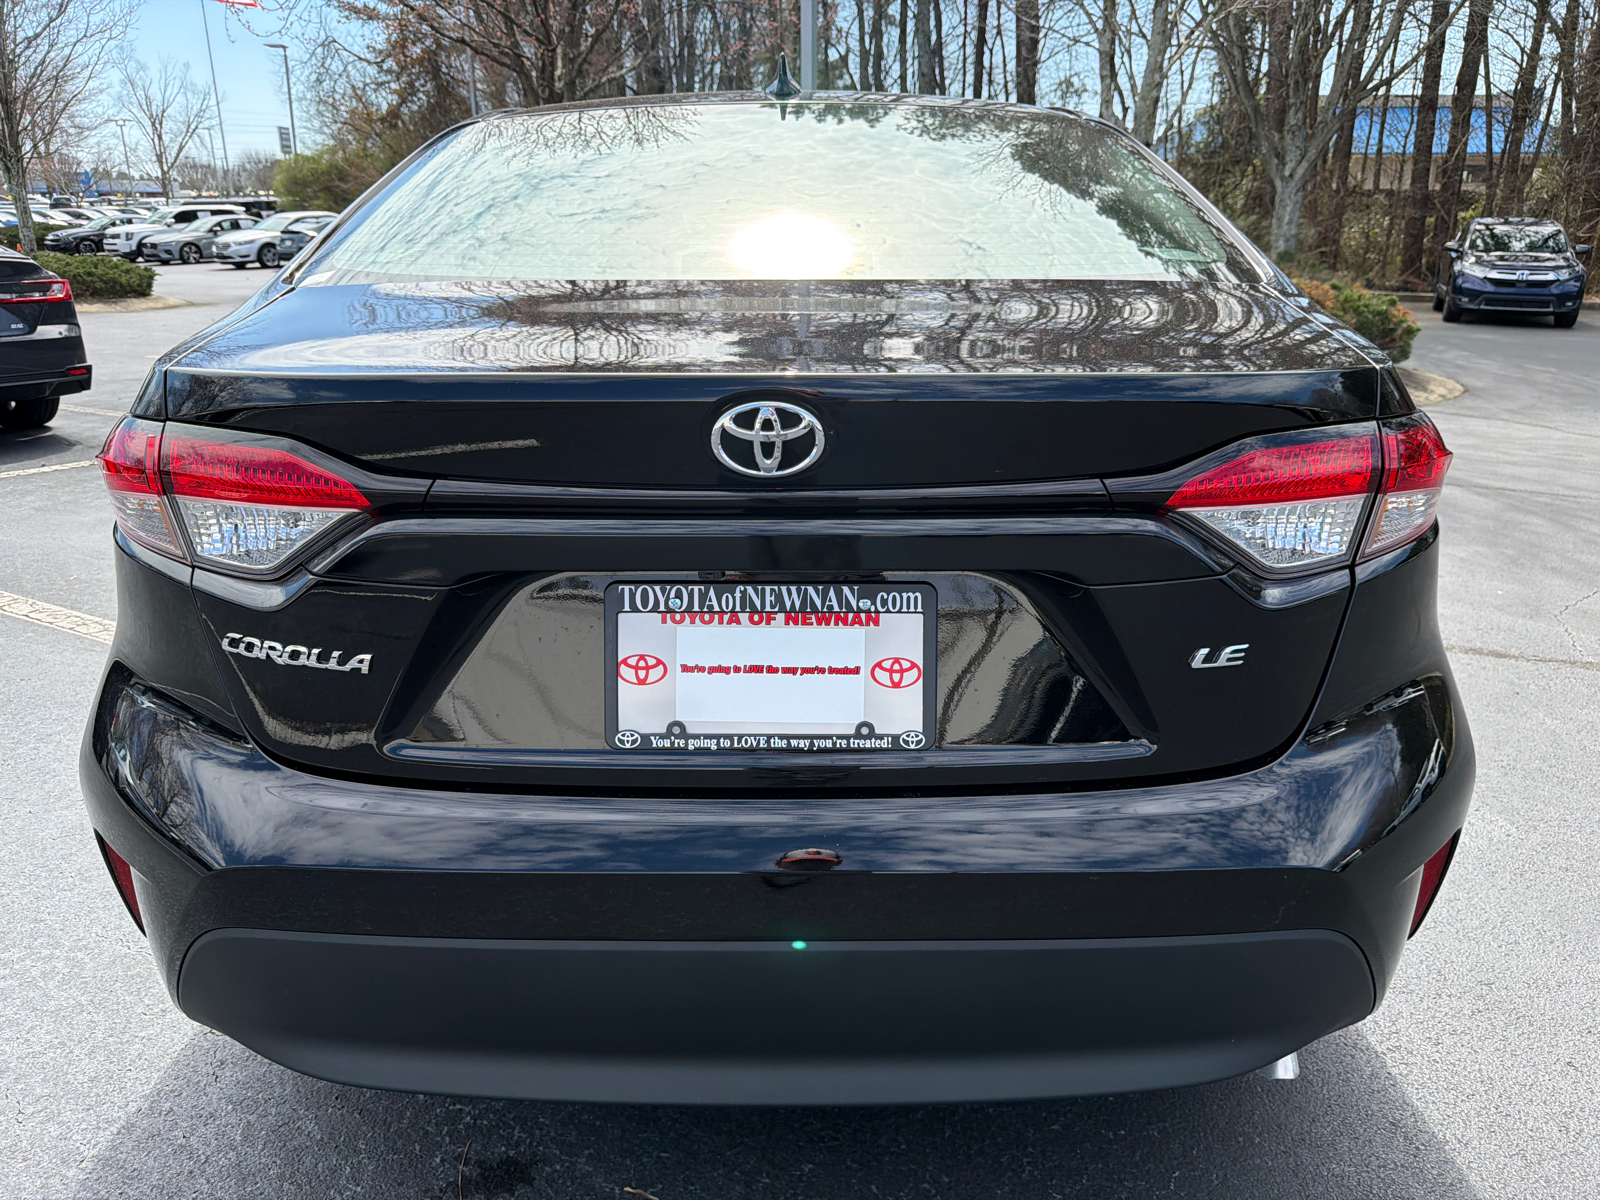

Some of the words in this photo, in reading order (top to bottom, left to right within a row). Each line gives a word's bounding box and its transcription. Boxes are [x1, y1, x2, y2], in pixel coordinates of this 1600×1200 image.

[658, 612, 742, 624] TOYOTA
[748, 612, 776, 625] OF
[784, 612, 881, 626] NEWNAN
[221, 632, 374, 674] COROLLA
[1188, 643, 1250, 669] LE
[680, 664, 706, 673] You're
[707, 664, 731, 675] going
[732, 665, 742, 673] to
[743, 665, 765, 674] LOVE
[765, 665, 780, 674] the
[781, 667, 799, 676] way
[800, 665, 826, 676] you're
[828, 666, 861, 675] treated!
[650, 736, 685, 747] You’re
[688, 736, 717, 750] going
[719, 737, 731, 747] to
[733, 736, 767, 747] LOVE
[770, 736, 787, 747] the
[790, 739, 811, 750] way
[813, 736, 847, 750] you’re
[850, 736, 892, 748] treated!
